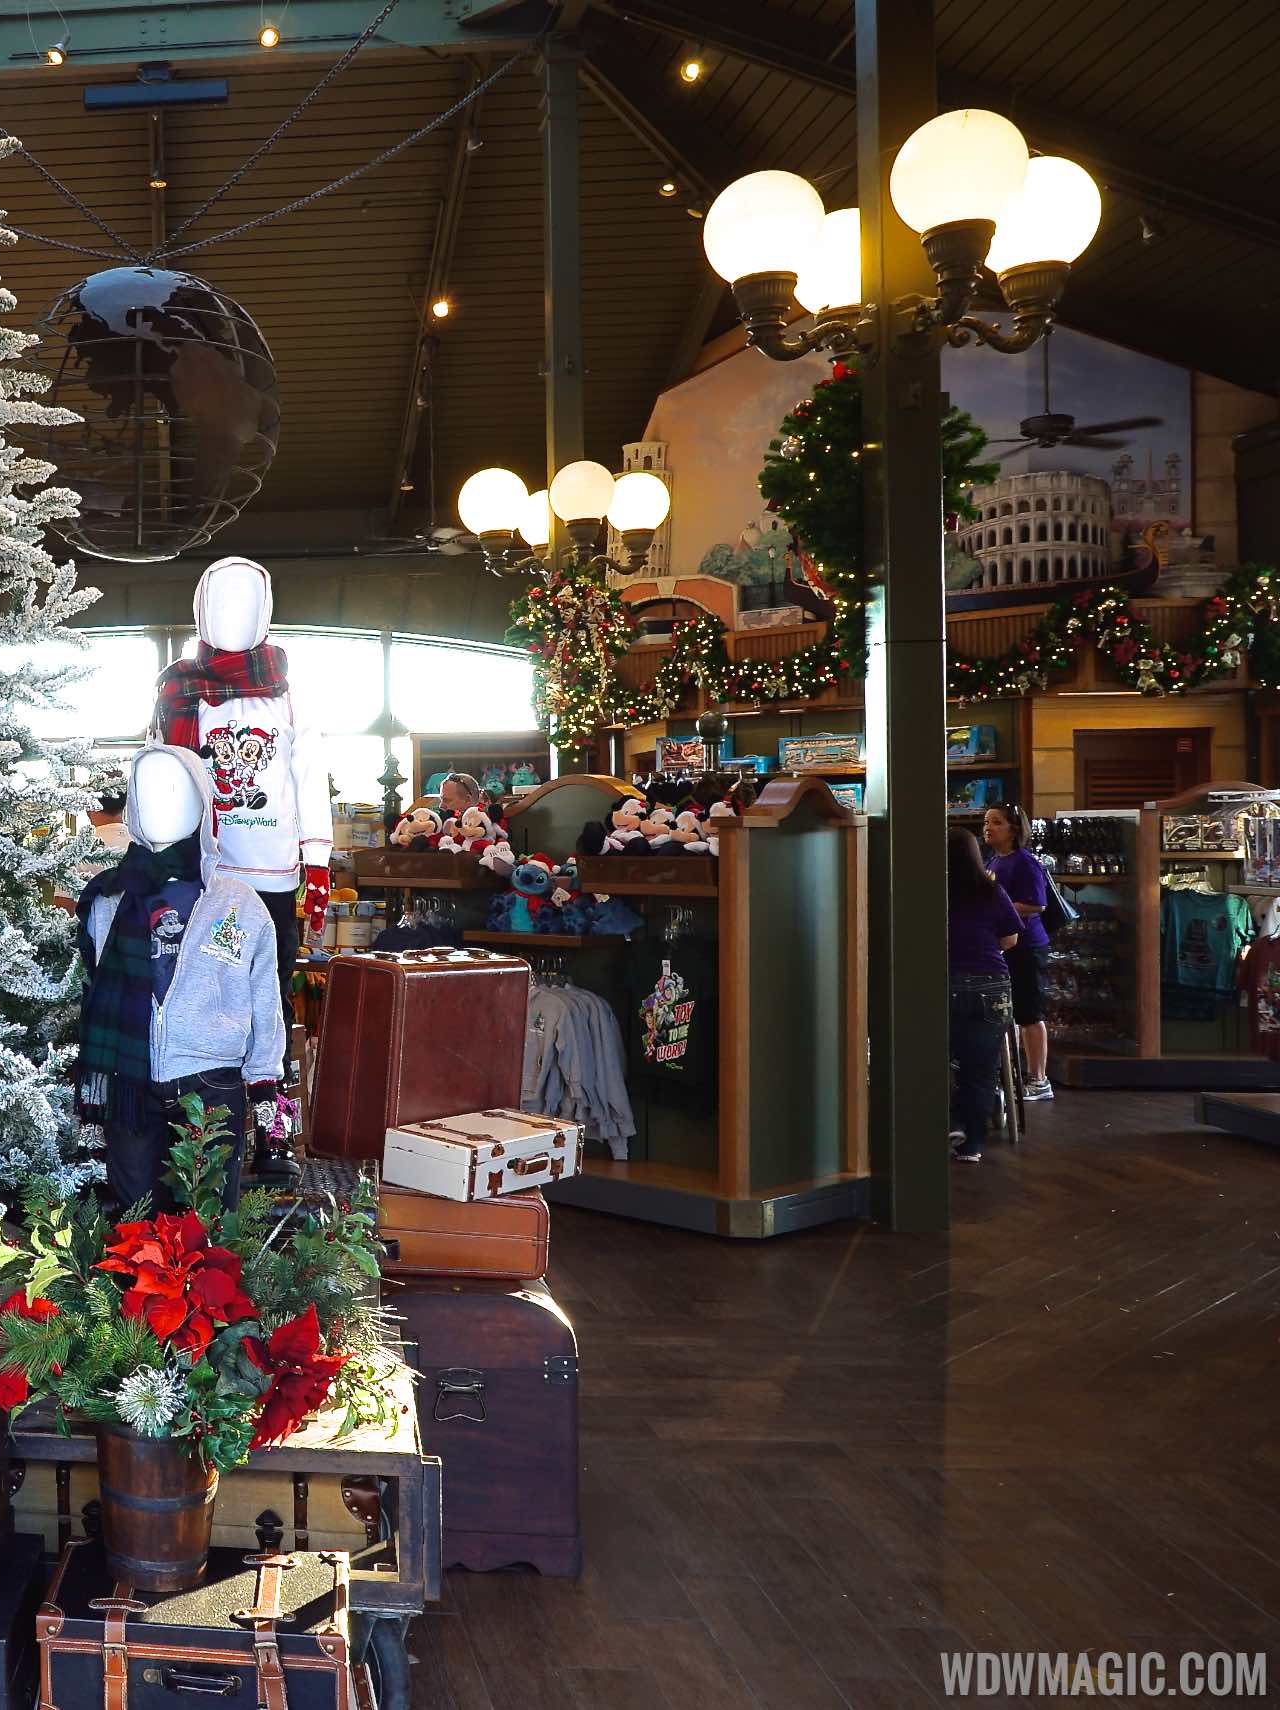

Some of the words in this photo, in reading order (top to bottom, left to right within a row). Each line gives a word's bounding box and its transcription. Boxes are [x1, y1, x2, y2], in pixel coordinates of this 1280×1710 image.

[218, 813, 256, 829] Disney
[255, 817, 278, 827] World
[668, 1028, 678, 1042] TO
